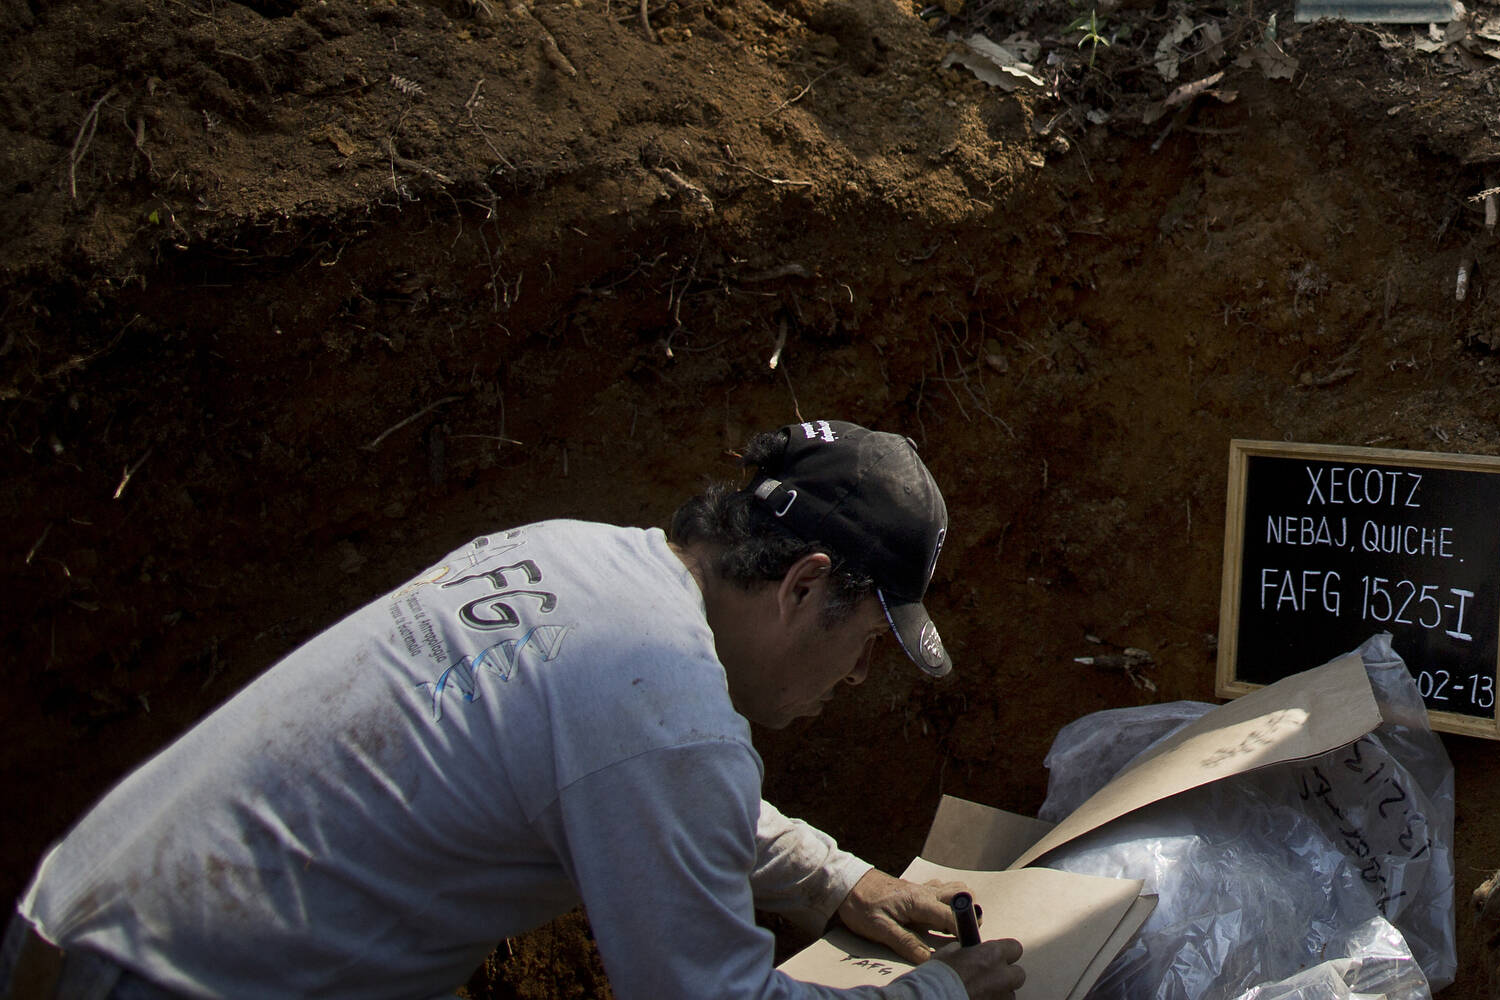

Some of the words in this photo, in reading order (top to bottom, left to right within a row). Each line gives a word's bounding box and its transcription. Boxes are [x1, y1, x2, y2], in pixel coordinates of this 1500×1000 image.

[1306, 466, 1422, 507] XECOTZ
[1361, 520, 1464, 563] QUICHE.
[1261, 568, 1341, 617] FAFG
